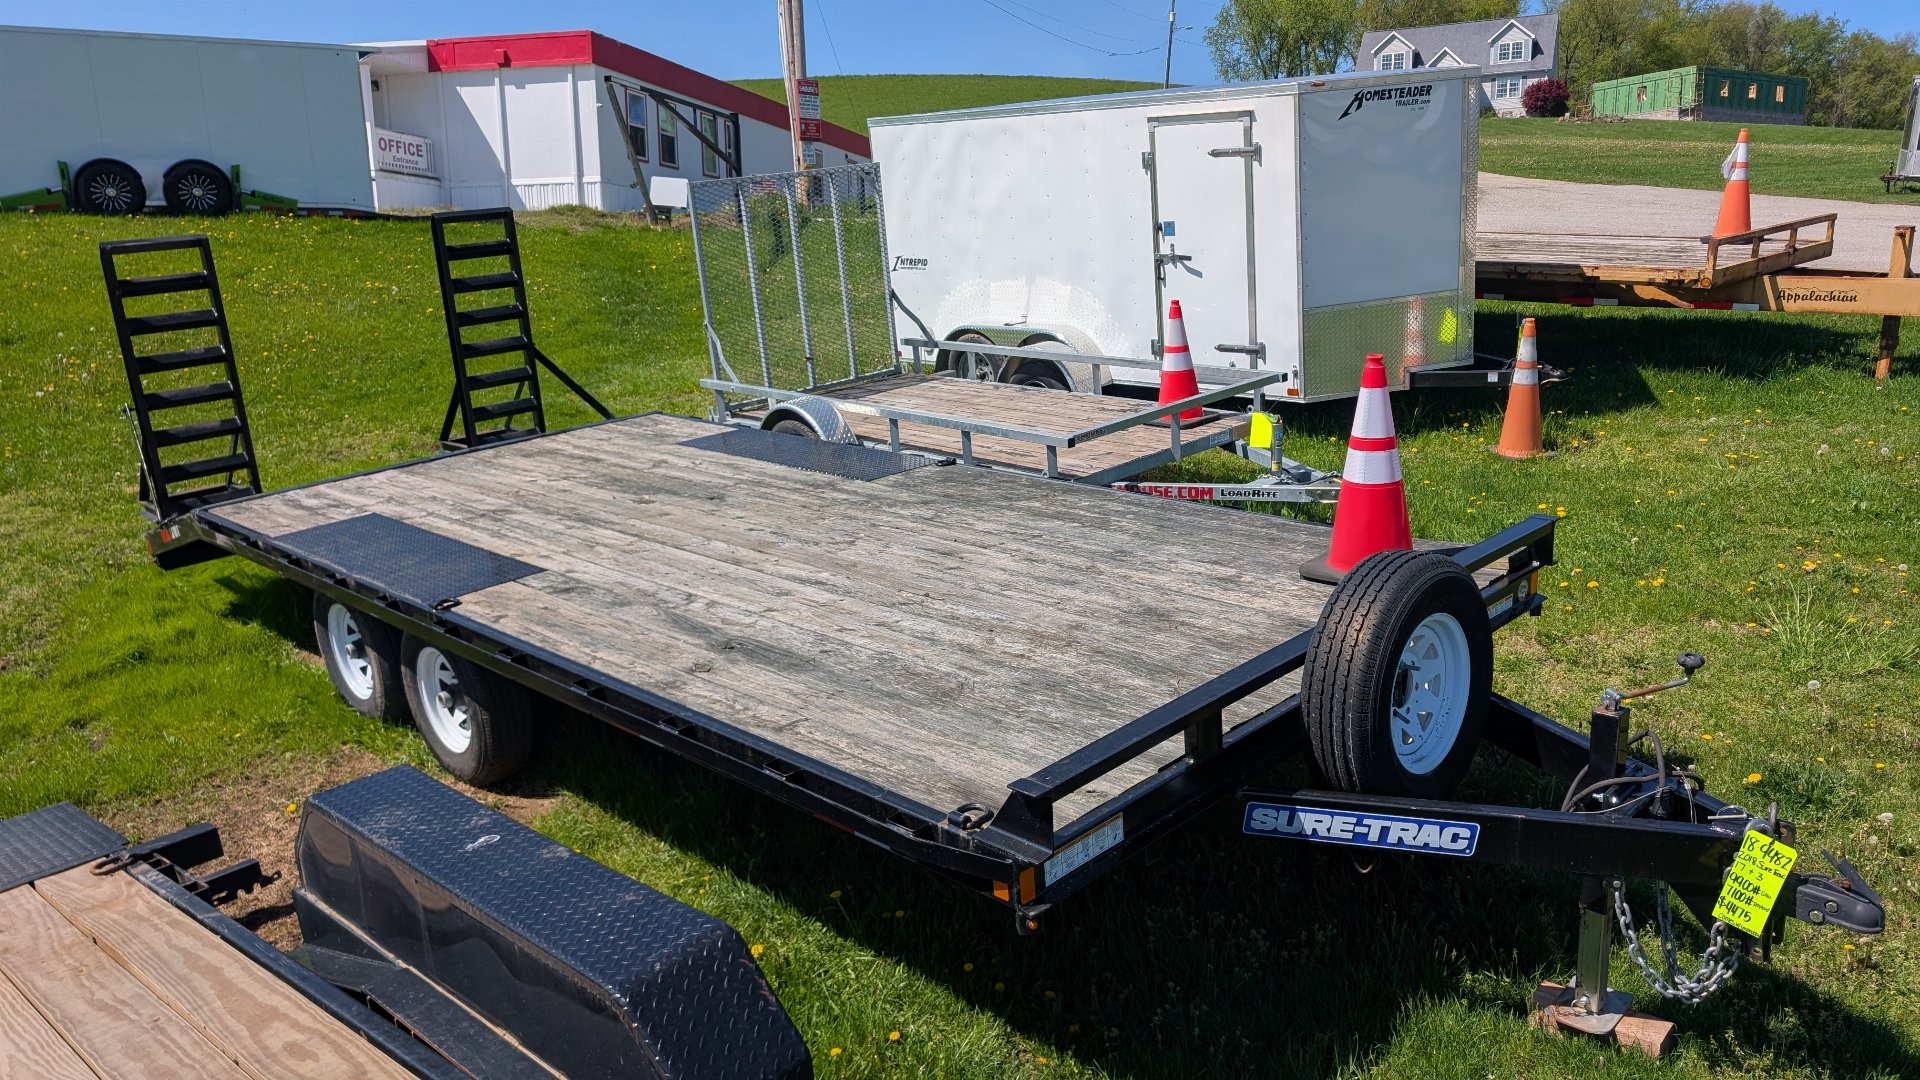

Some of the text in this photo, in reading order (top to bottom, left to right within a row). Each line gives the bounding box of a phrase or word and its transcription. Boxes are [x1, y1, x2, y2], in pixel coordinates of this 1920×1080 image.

[1338, 85, 1432, 120] HOMESTEADER
[378, 136, 424, 158] OFFICE
[392, 155, 419, 166] Entrance
[891, 255, 928, 272] INTREPID
[1776, 289, 1858, 303] Appalachian
[1251, 808, 1471, 850] SURE-TRAC
[1738, 851, 1757, 866] 2018
[1735, 861, 1746, 871] 17
[1756, 873, 1764, 881] 3
[1718, 895, 1752, 922] $4475
